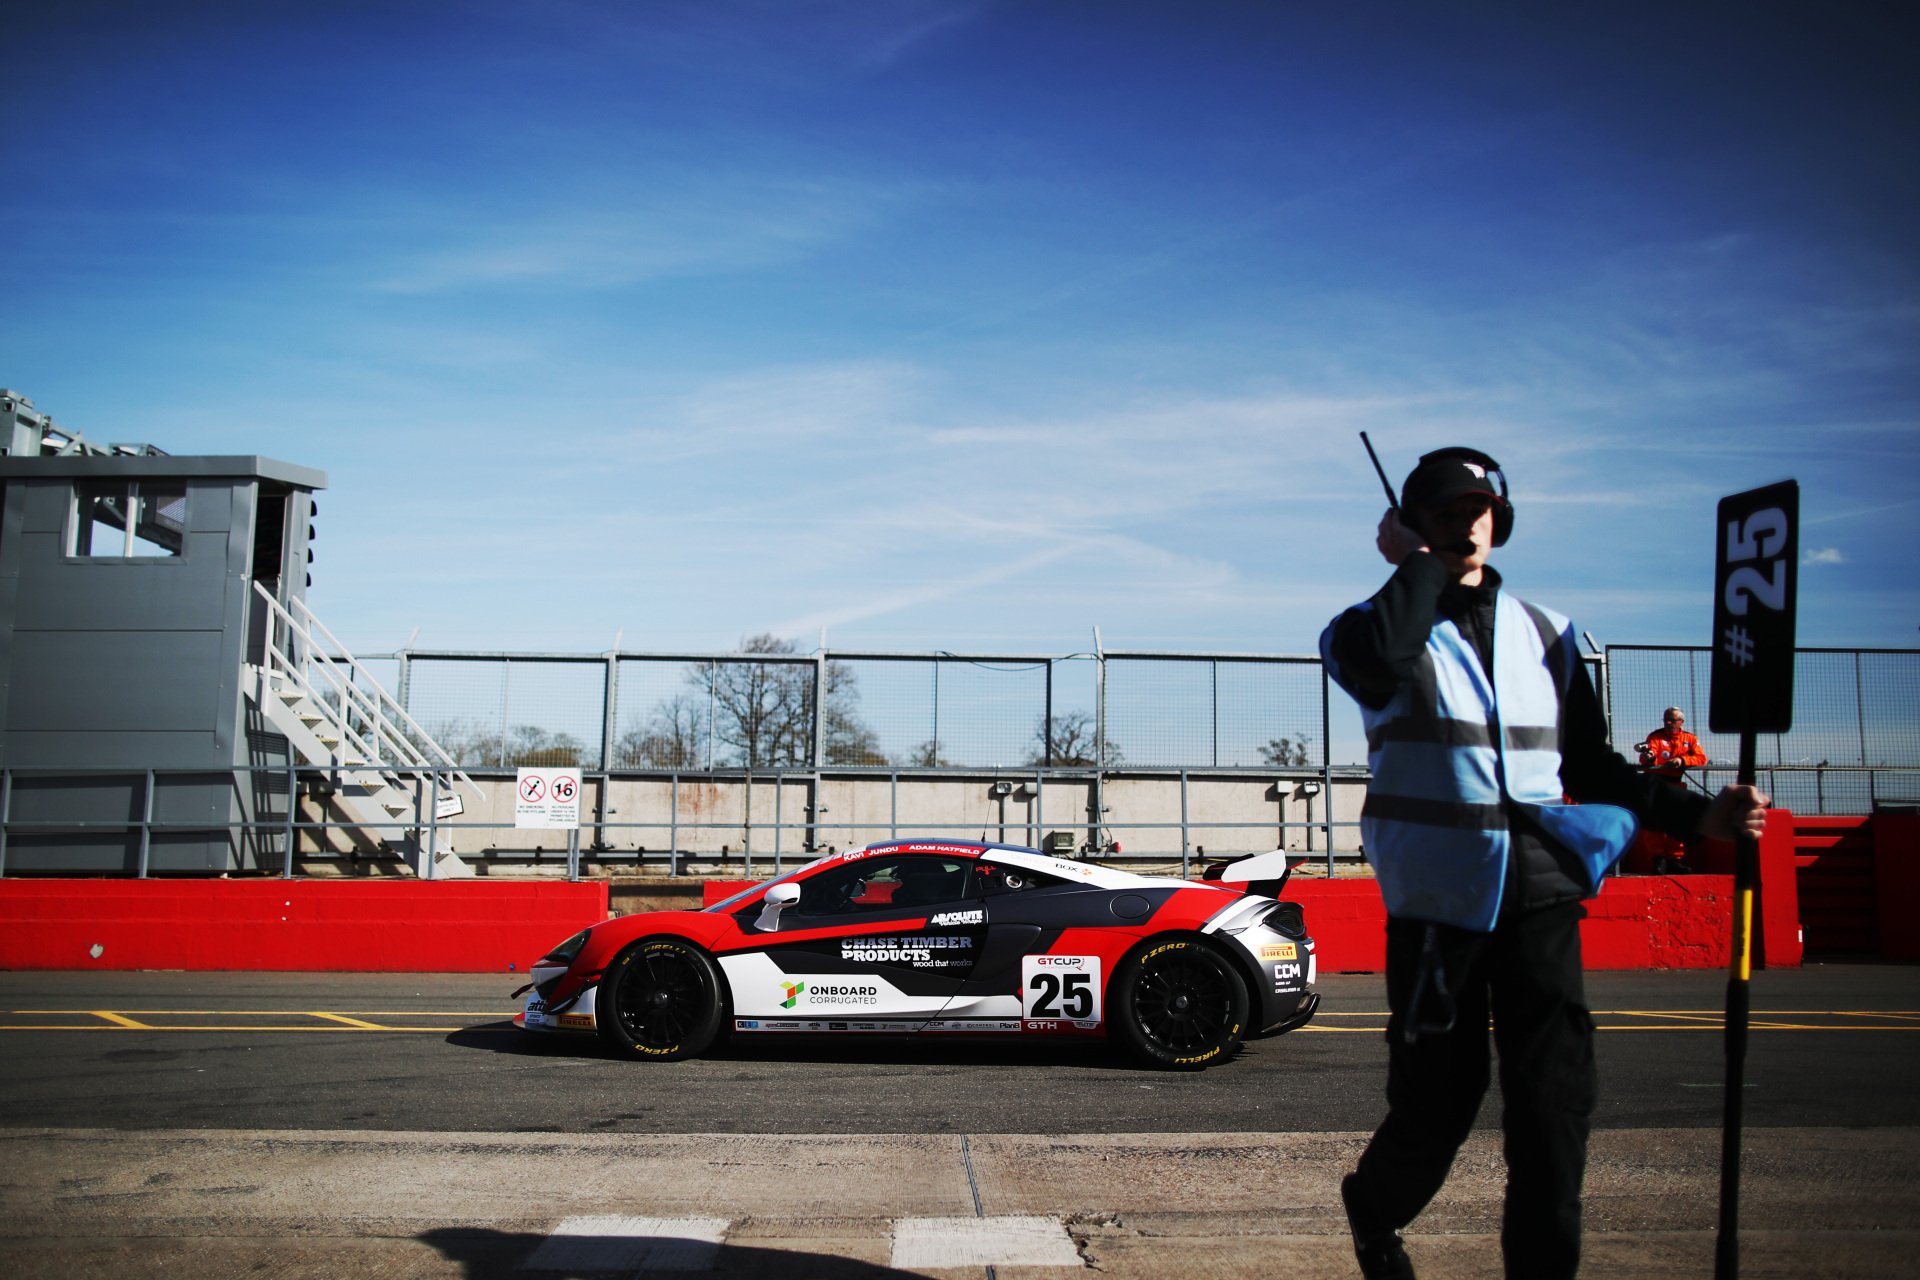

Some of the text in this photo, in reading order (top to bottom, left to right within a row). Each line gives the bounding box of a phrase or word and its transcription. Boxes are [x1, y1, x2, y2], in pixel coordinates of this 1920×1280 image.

[554, 783, 573, 797] 16
[843, 852, 864, 862] KAVI
[868, 846, 899, 856] JUNDU
[937, 845, 980, 855] HATFIELD
[931, 910, 983, 923] ABSOLUTE
[841, 937, 973, 949] CHASE TIMBER
[841, 949, 931, 961] PRODUCTS
[1261, 946, 1294, 957] PIRELLI
[1274, 963, 1301, 979] CCM
[810, 986, 877, 996] ONBOARD
[1030, 973, 1094, 1019] 25
[810, 996, 877, 1005] CORRUGATED
[1027, 1022, 1057, 1030] GTH
